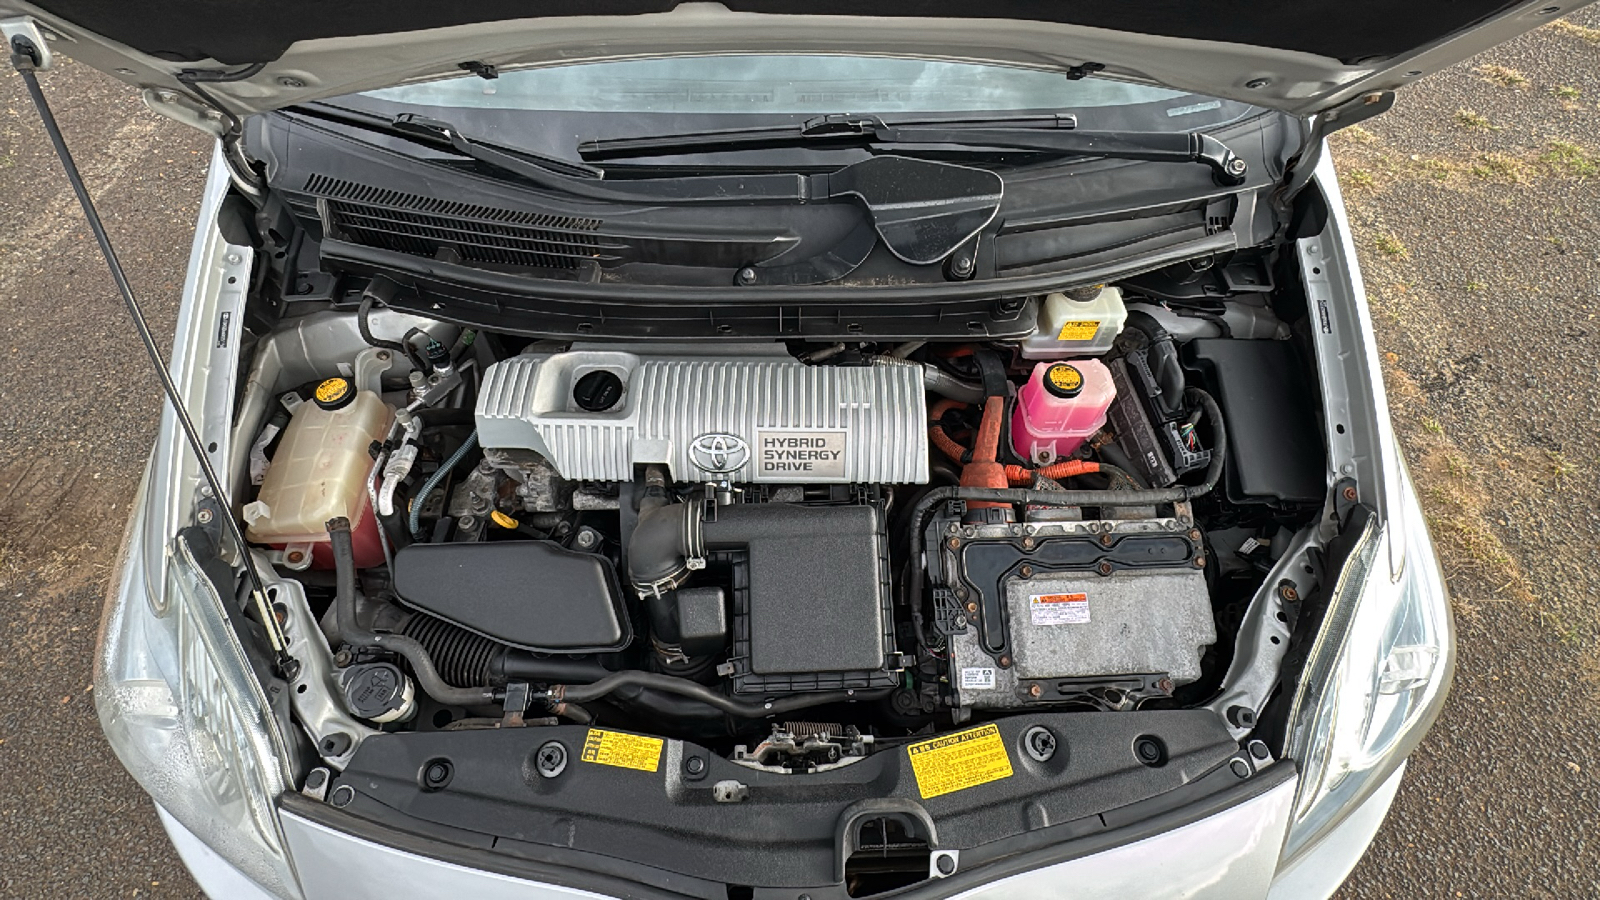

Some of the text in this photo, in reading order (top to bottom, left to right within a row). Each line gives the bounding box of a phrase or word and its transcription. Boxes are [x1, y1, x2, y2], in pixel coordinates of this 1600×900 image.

[764, 438, 826, 448] HYBRID
[764, 450, 841, 460] SYNERGY
[764, 462, 813, 471] DRIVE
[932, 737, 960, 749] CAUTION
[961, 727, 996, 742] ATTENTION
